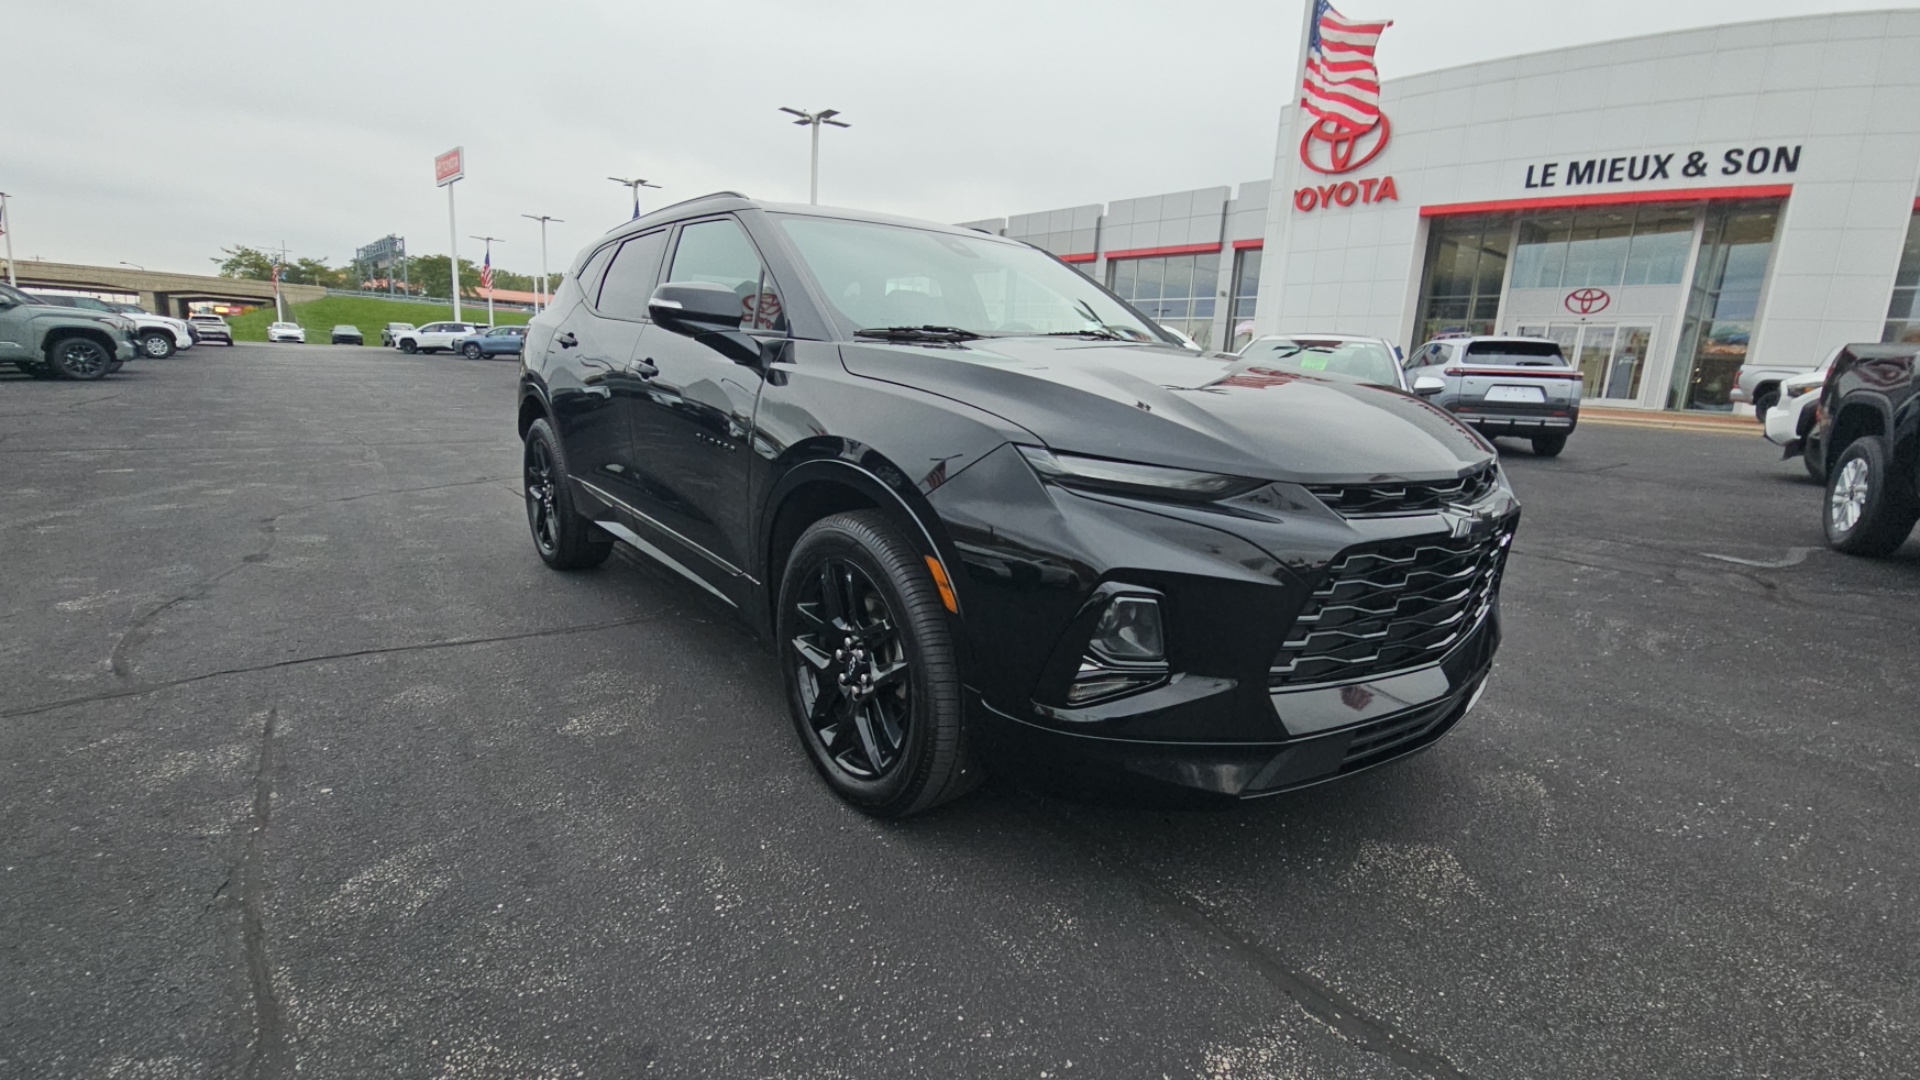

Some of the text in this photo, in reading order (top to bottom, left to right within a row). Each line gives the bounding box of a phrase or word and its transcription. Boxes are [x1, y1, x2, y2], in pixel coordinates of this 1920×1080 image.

[1525, 145, 1802, 189] LE MIEUX & SON
[1294, 176, 1398, 212] OYOTA
